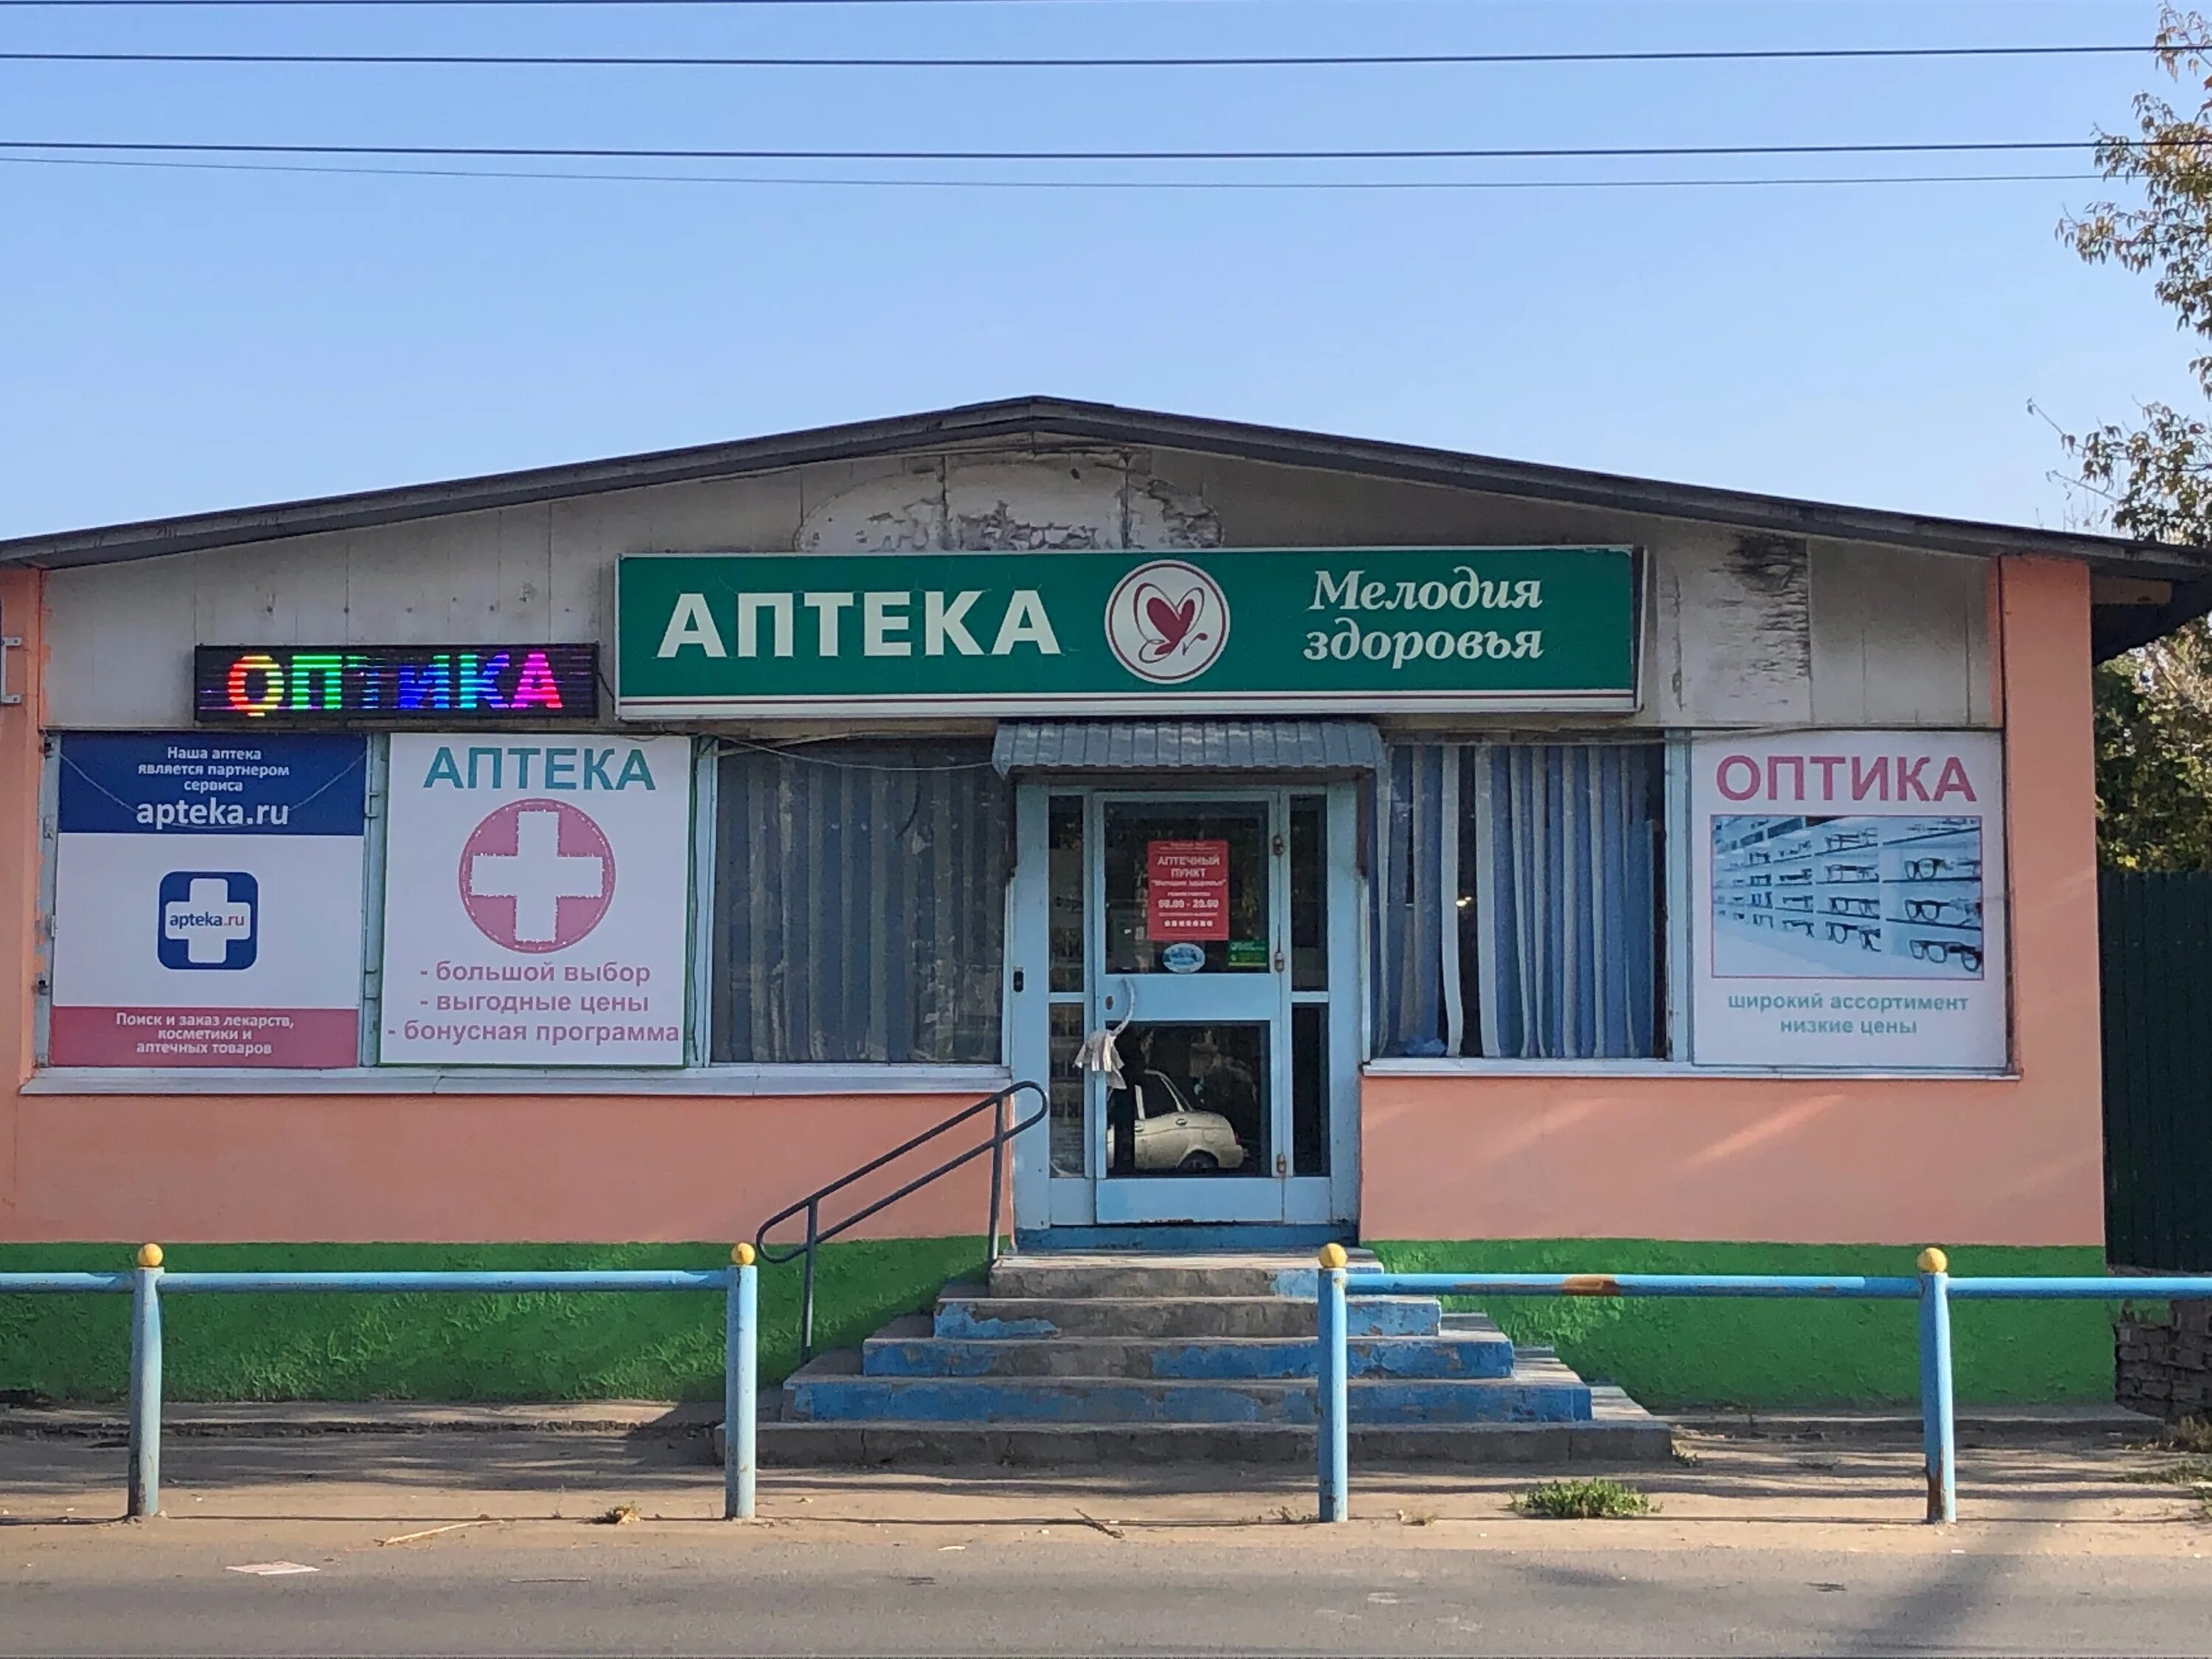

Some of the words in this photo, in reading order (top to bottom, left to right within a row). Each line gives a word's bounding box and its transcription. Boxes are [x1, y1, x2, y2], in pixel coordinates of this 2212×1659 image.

[1309, 566, 1543, 612] Мелодия
[656, 590, 1061, 658] АПТЕКА
[1304, 618, 1543, 669] здоровья
[227, 653, 563, 717] ОПТИКА
[167, 746, 208, 759] Наша
[212, 749, 262, 760] аптека
[138, 765, 204, 775] является
[208, 765, 290, 779] партнером
[423, 746, 655, 791] АПТЕКА
[1717, 754, 1978, 802] ОПТИКА
[184, 780, 243, 793] сервиса
[136, 797, 290, 830] apteka.ru
[1158, 855, 1220, 866] АПТЕЧНЫЙ
[1171, 868, 1206, 877] ПУНКТ
[170, 911, 245, 929] apteka.ru
[437, 961, 554, 981] большой
[564, 961, 651, 986] выбор
[437, 995, 571, 1014] выгодные
[580, 995, 649, 1014] цены
[1728, 992, 1823, 1012] широкий
[1830, 995, 1969, 1013] ассортимент
[116, 1012, 162, 1026] Поиск
[166, 1015, 175, 1026] и
[178, 1015, 220, 1026] заказ
[223, 1016, 294, 1029] лекарств,
[1780, 1020, 1854, 1033] низкие
[1860, 1020, 1917, 1035] цены
[158, 1029, 238, 1040] косметики
[243, 1029, 252, 1040] и
[404, 1020, 527, 1046] бонусная
[536, 1024, 679, 1046] программа
[136, 1042, 207, 1054] аптечных
[212, 1043, 272, 1057] товаров
